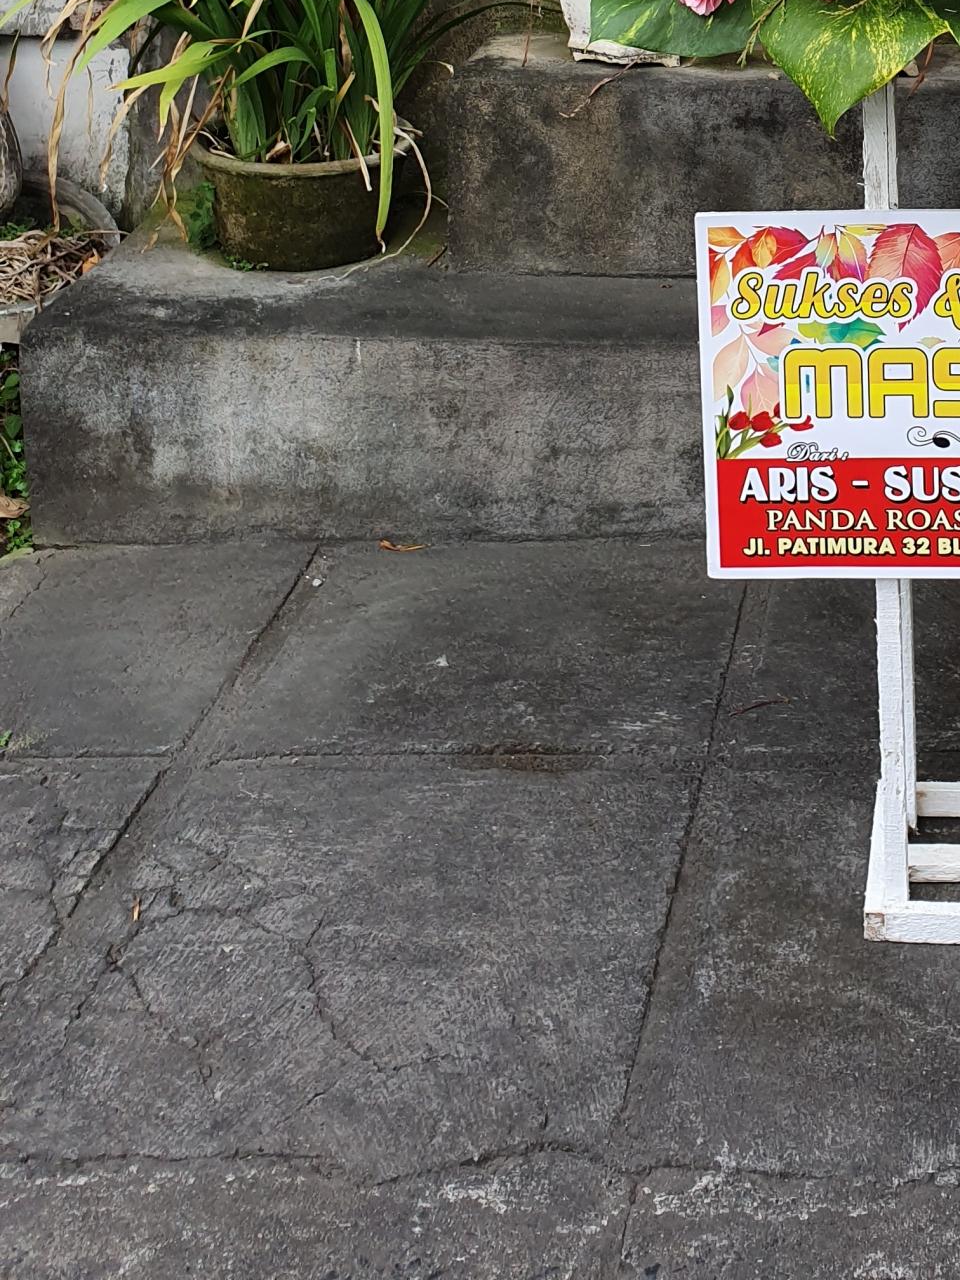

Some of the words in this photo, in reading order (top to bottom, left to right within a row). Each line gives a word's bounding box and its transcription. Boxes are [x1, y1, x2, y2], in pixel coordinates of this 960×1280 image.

[731, 271, 914, 320] Sukses
[786, 442, 838, 462] Dari
[740, 466, 838, 503] ARIS
[767, 509, 875, 530] PANDA
[778, 538, 896, 555] PATIMURA
[902, 538, 930, 555] 32
